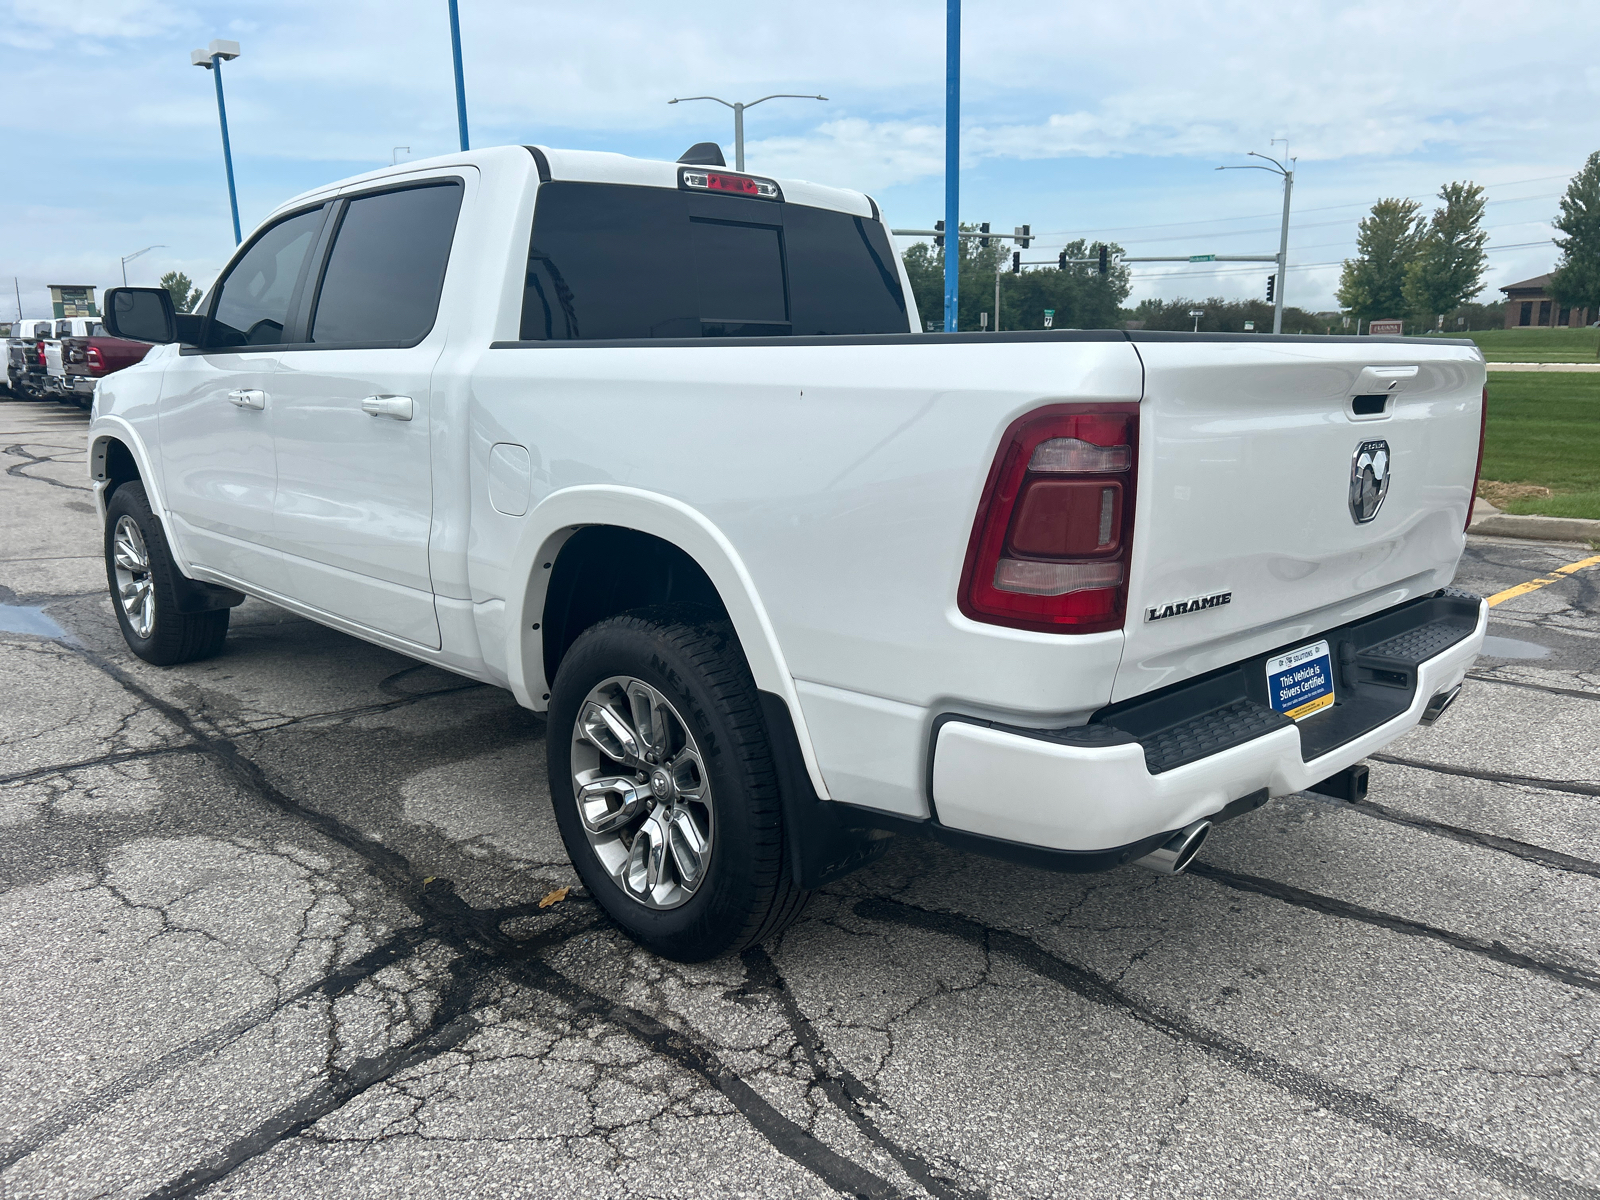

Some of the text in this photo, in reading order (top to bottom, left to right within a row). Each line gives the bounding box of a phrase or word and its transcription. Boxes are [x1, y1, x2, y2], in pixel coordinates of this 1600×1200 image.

[1144, 590, 1232, 622] LARAMIE
[1293, 650, 1313, 662] SOLUTIONS
[1280, 664, 1320, 687] This Vehicle is
[1280, 674, 1324, 700] Stivers Certified
[650, 653, 721, 758] NEXEN
